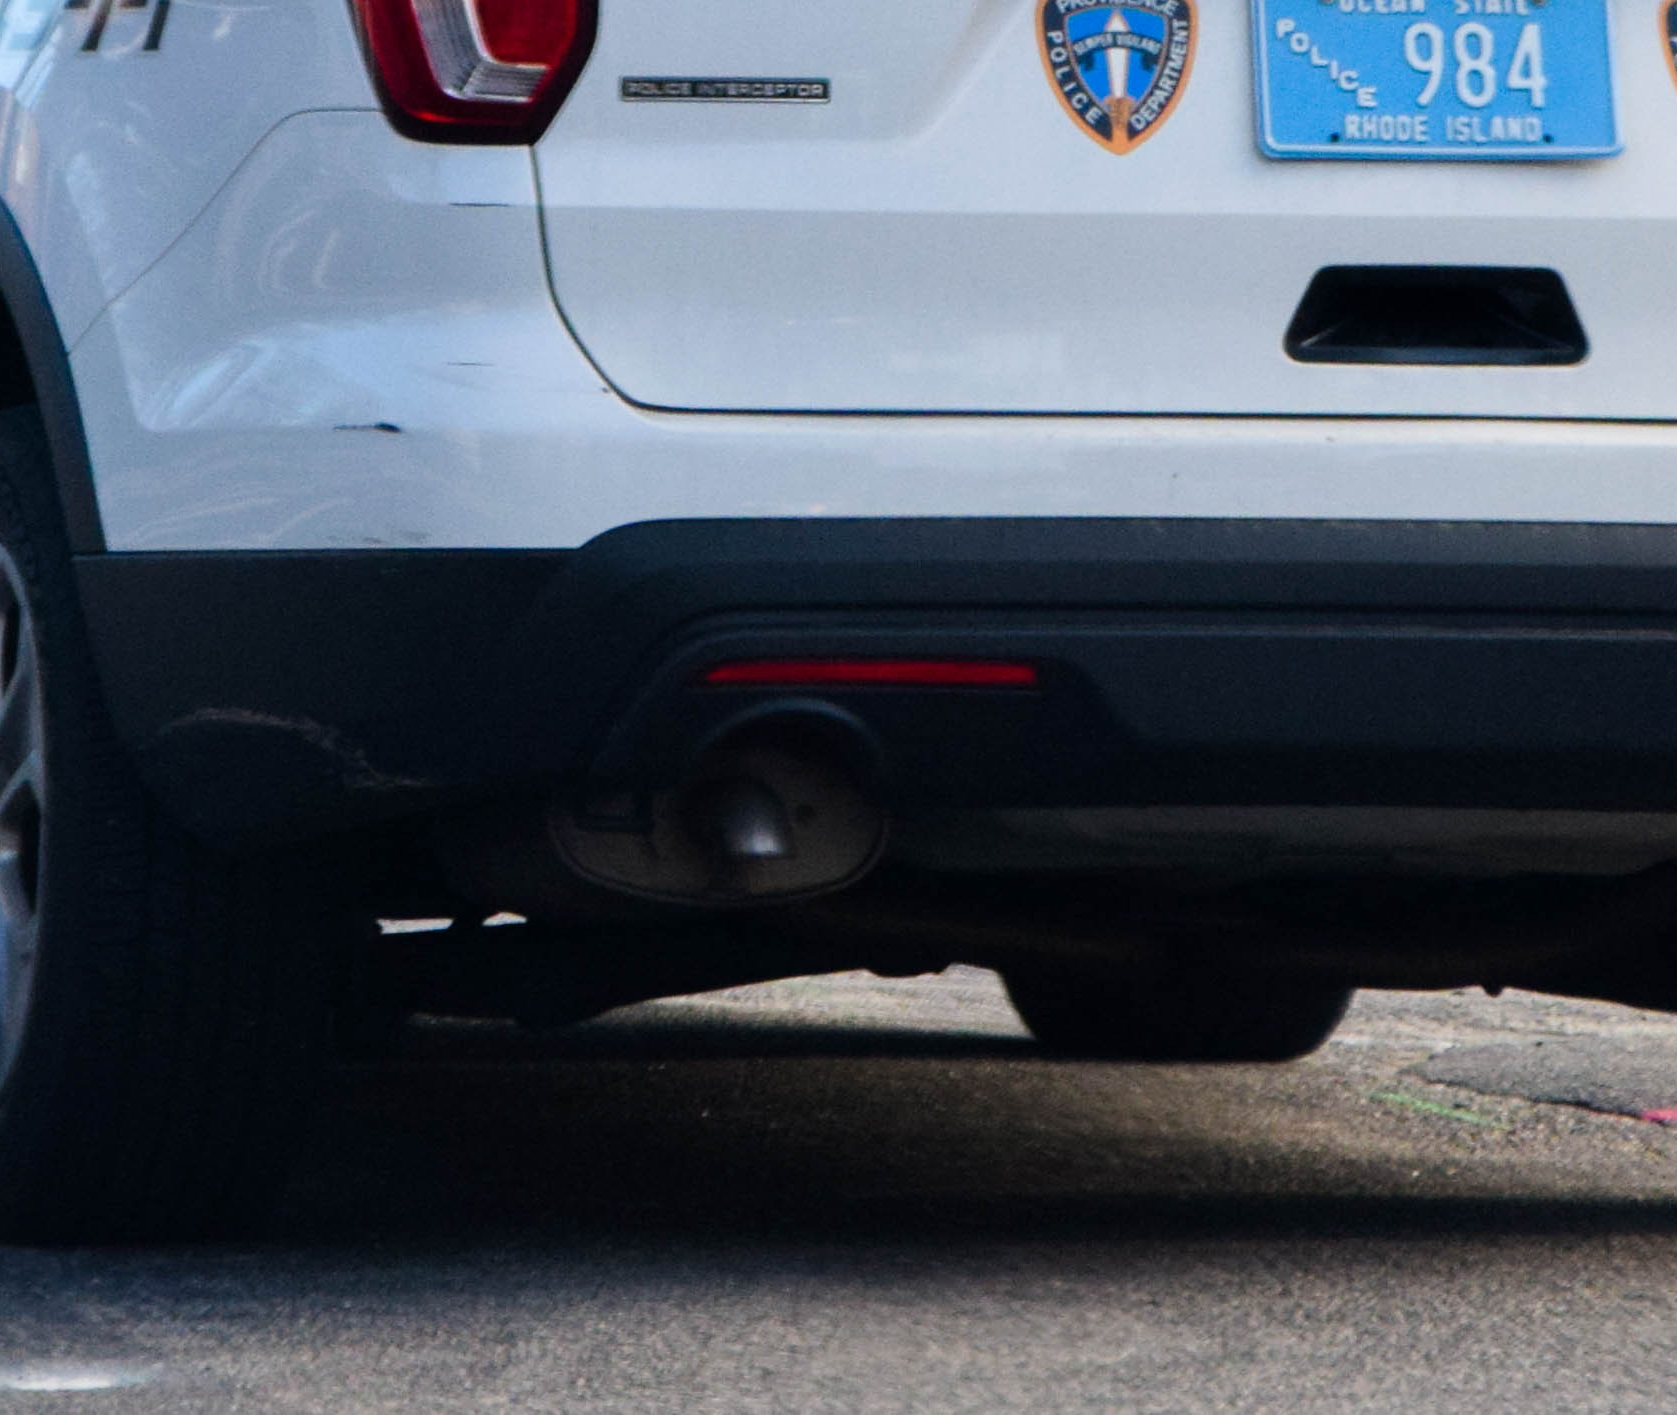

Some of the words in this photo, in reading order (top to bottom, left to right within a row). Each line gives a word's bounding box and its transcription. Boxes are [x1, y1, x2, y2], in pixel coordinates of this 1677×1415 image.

[1046, 30, 1103, 125] POLICE
[1129, 18, 1190, 132] DEPARTMENT
[1275, 18, 1378, 108] POLICE
[1403, 21, 1548, 109] 984
[1344, 114, 1430, 141] RHODE
[1446, 115, 1543, 143] ISLAND
